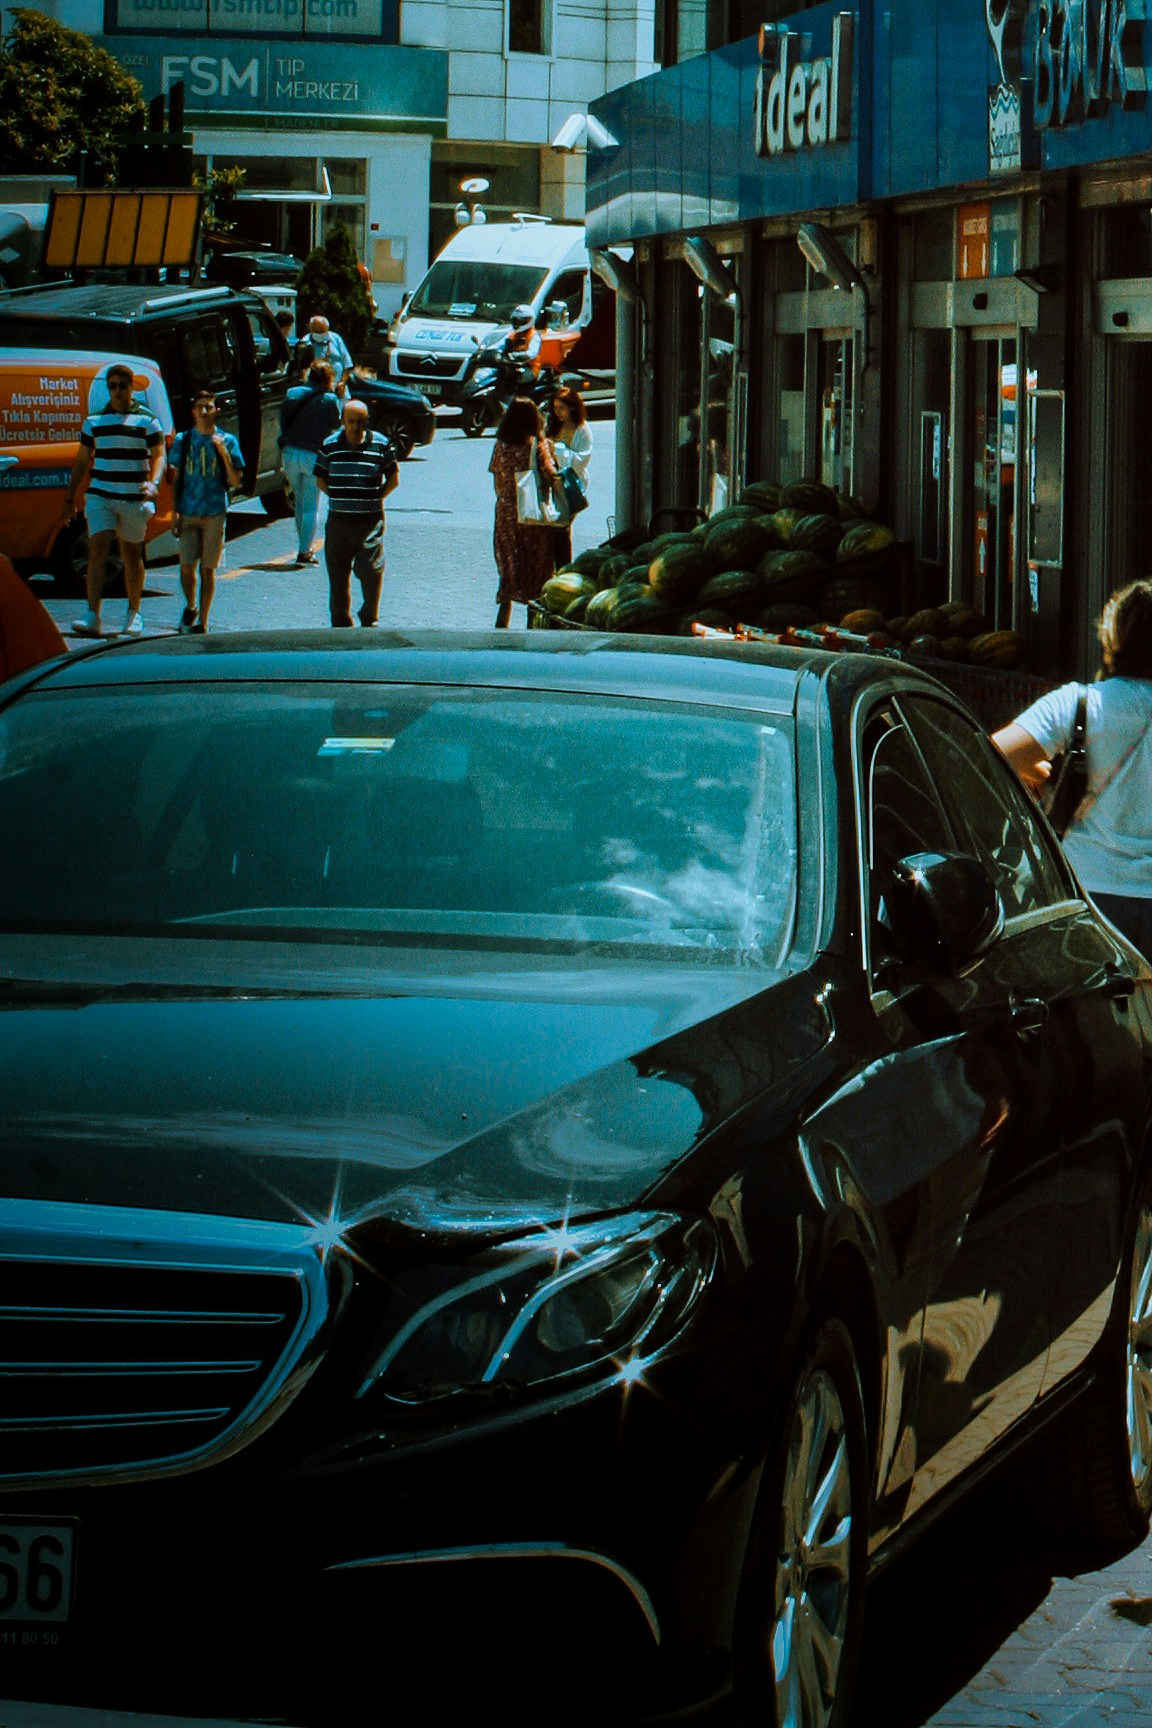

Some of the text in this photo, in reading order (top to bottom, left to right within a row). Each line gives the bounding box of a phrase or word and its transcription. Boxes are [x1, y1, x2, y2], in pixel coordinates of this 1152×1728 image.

[160, 54, 260, 98] FSM
[276, 57, 305, 76] TIP
[276, 79, 359, 101] MERKEZİ
[754, 15, 841, 155] ideal
[40, 377, 79, 390] Market
[11, 392, 80, 409] Alışverişiniz
[2, 409, 81, 426] Tıkla Kapınıza
